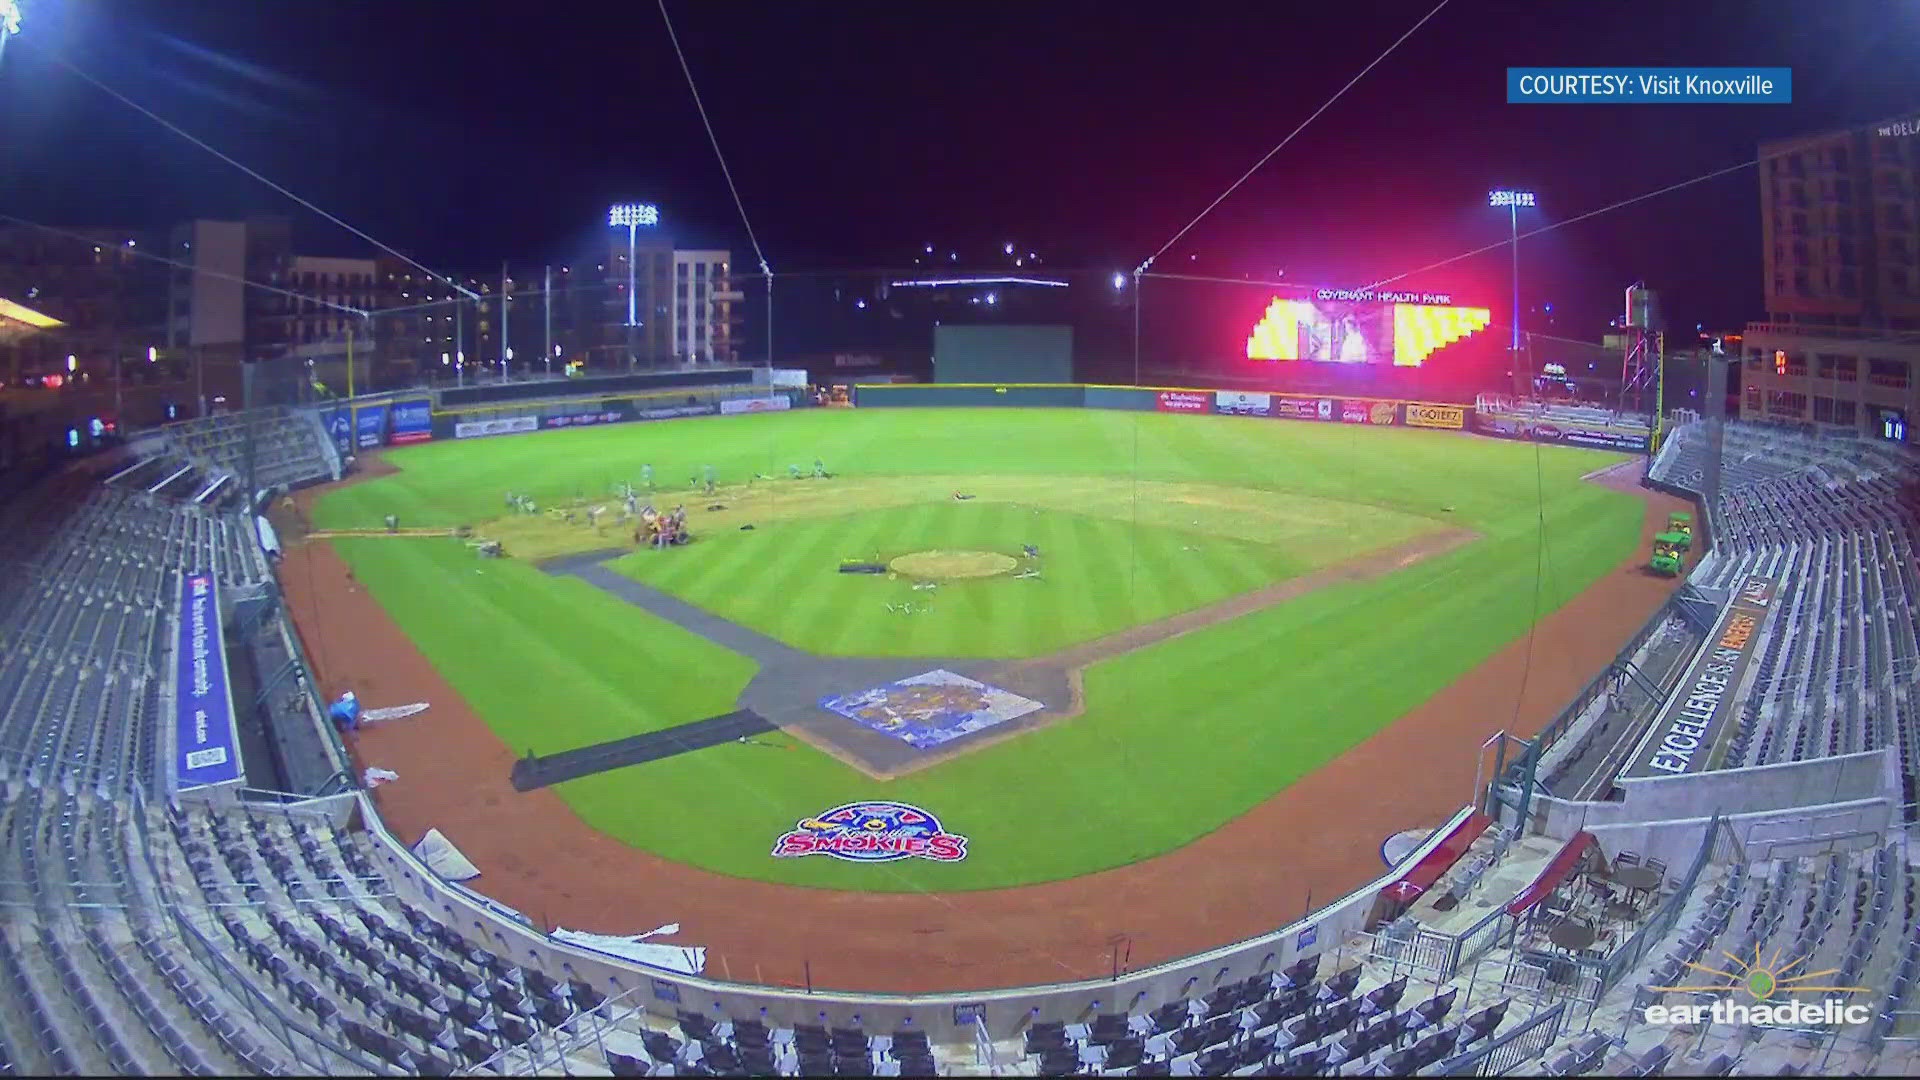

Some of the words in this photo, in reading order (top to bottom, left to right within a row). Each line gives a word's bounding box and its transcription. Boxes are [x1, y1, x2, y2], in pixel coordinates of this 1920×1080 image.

[1316, 289, 1374, 301] COVENANT
[1377, 290, 1419, 302] HEALTH
[1422, 293, 1451, 304] PARK
[1649, 672, 1728, 774] EXCELLENCE
[784, 832, 966, 860] SMOKIES
